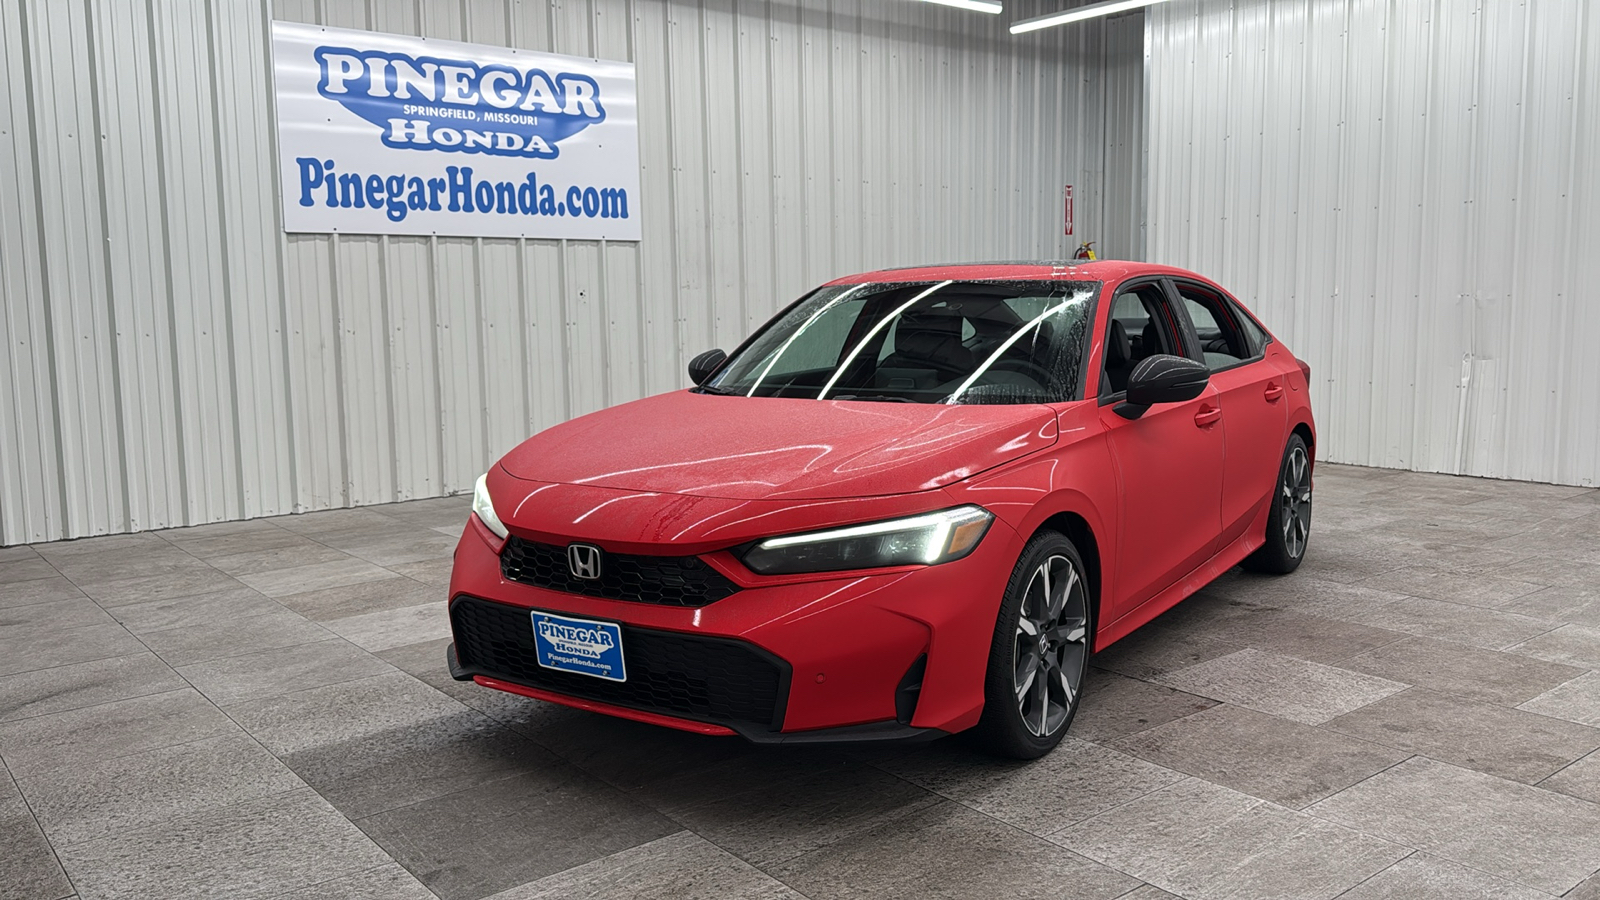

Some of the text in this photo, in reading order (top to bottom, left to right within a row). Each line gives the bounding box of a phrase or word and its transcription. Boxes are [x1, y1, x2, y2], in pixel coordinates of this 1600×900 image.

[320, 52, 602, 118] PINEGAR
[403, 104, 538, 126] SPRINGFIELD, MISSOURI
[387, 118, 554, 153] HONDA
[296, 157, 629, 222] PinegarHonda.com
[539, 622, 613, 646] PINEGAR
[547, 652, 612, 670] PinegarHonda.com
[555, 642, 599, 658] HONDA
